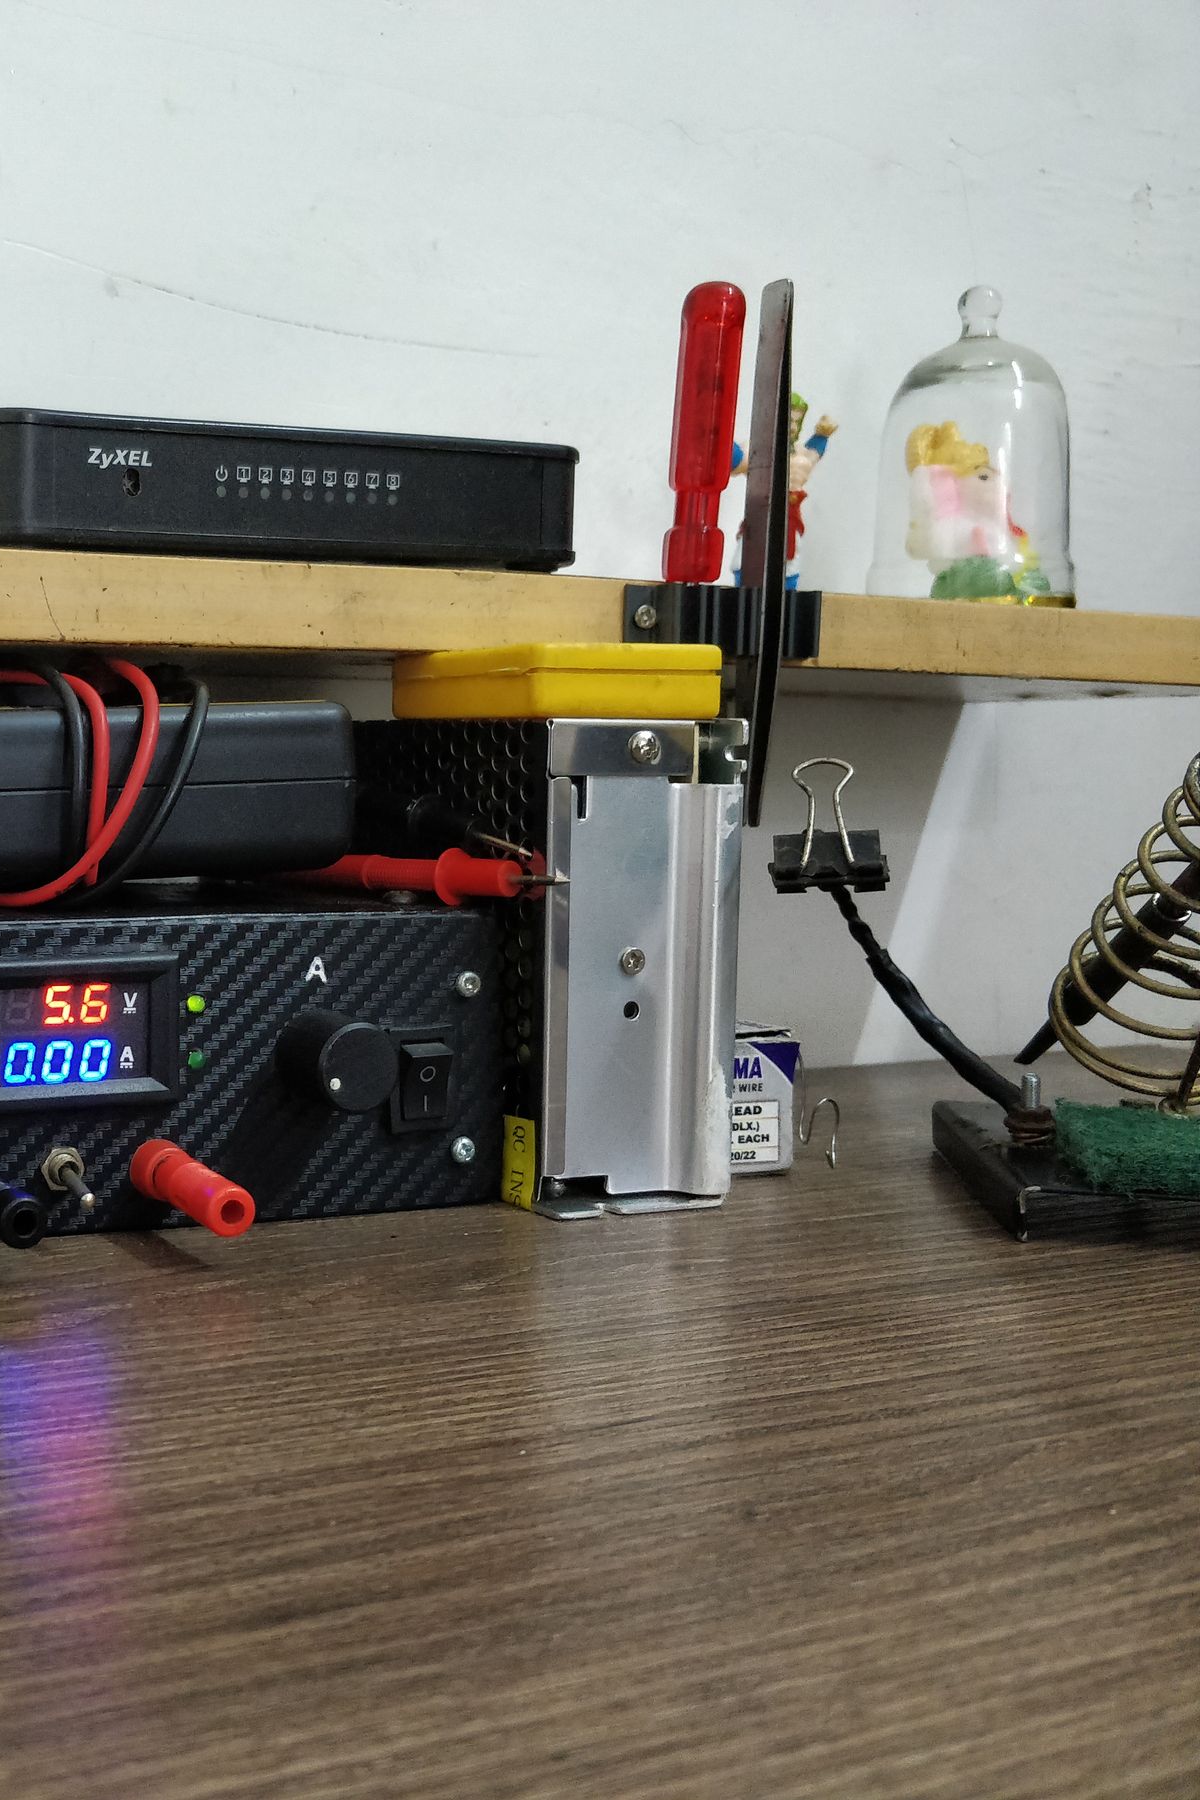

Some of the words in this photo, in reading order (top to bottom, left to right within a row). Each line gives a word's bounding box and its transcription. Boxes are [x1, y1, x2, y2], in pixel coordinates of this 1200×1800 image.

[87, 447, 153, 469] ZyXEL
[305, 956, 327, 983] A
[43, 984, 111, 1025] 5.6
[122, 992, 138, 1008] V
[3, 1039, 112, 1084] 0.00
[119, 1045, 135, 1062] A
[739, 1083, 763, 1092] WIRE
[732, 1106, 763, 1116] EAD
[512, 1126, 525, 1152] QC
[738, 1134, 770, 1144] EACH
